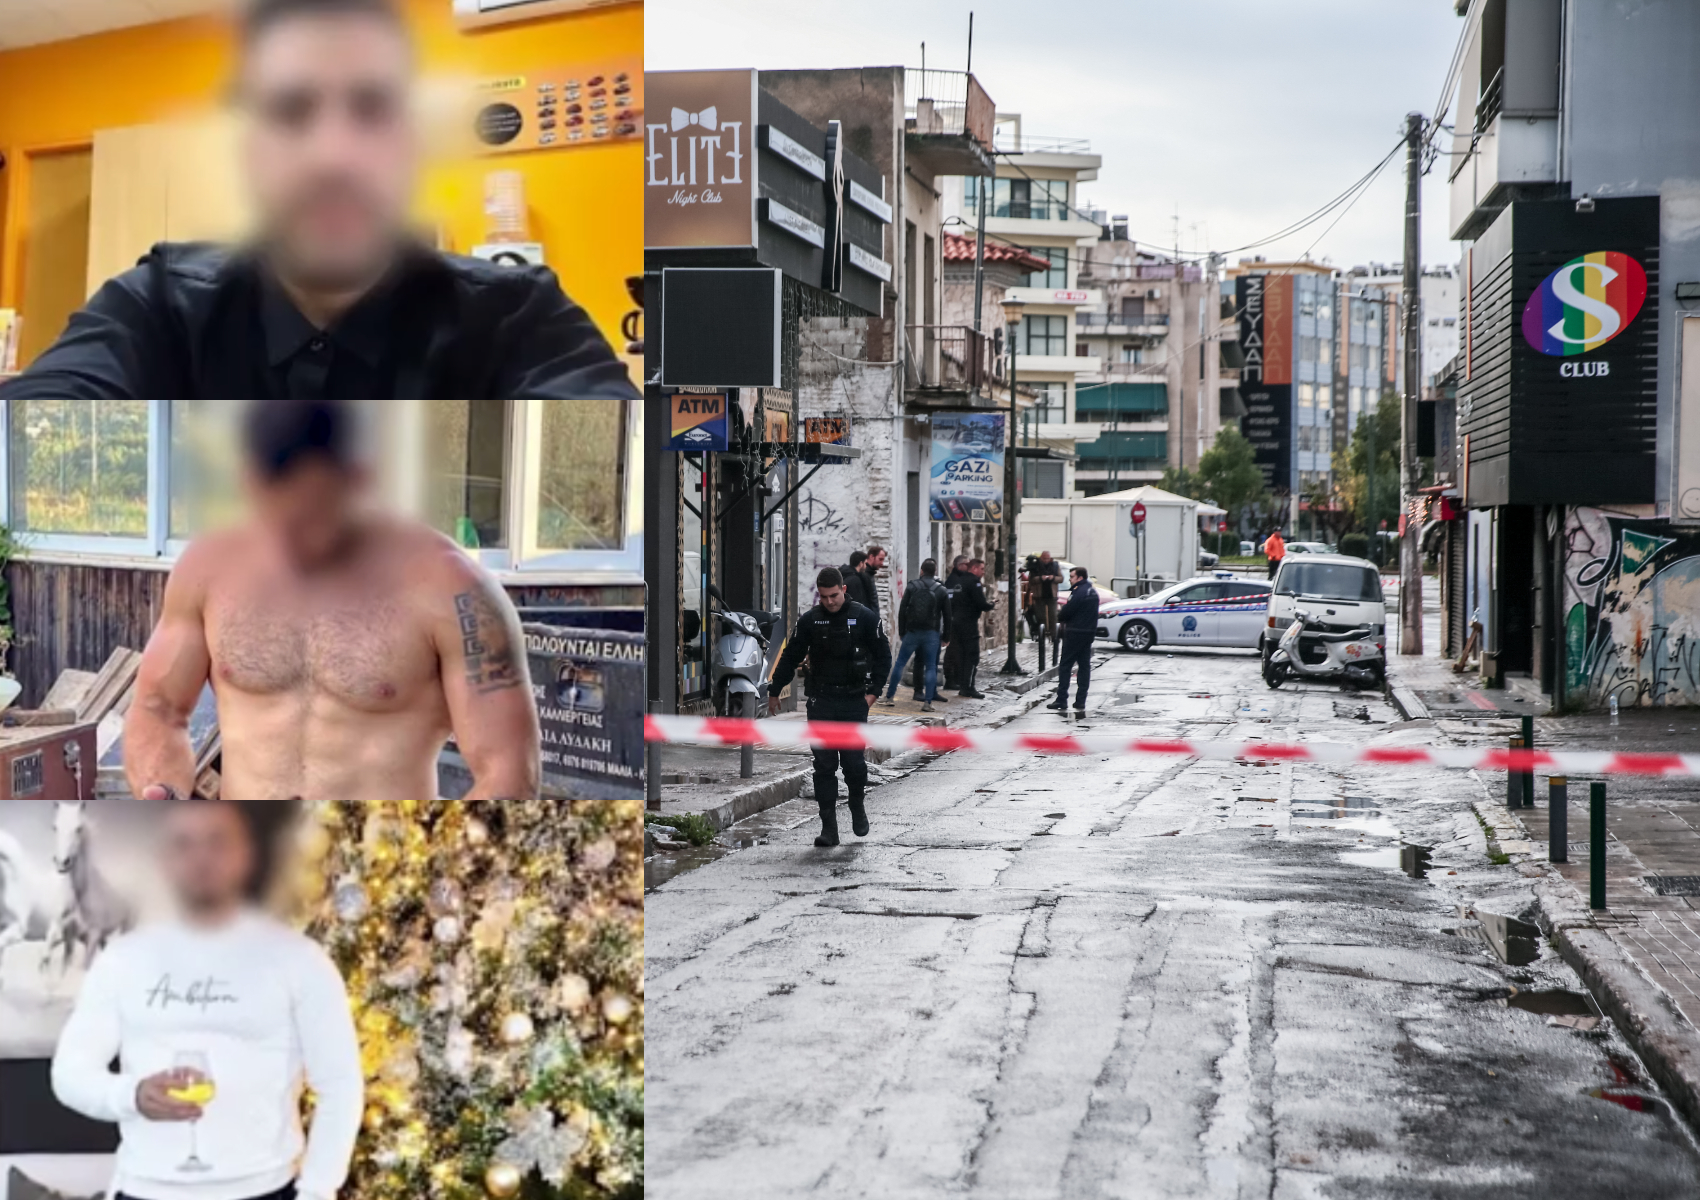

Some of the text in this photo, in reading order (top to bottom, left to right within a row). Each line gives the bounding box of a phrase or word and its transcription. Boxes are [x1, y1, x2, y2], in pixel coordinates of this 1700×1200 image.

[645, 121, 743, 186] ELITE
[667, 188, 722, 207] Night Club
[1547, 262, 1620, 344] S
[1560, 361, 1610, 377] CLUB
[678, 399, 719, 414] ATM
